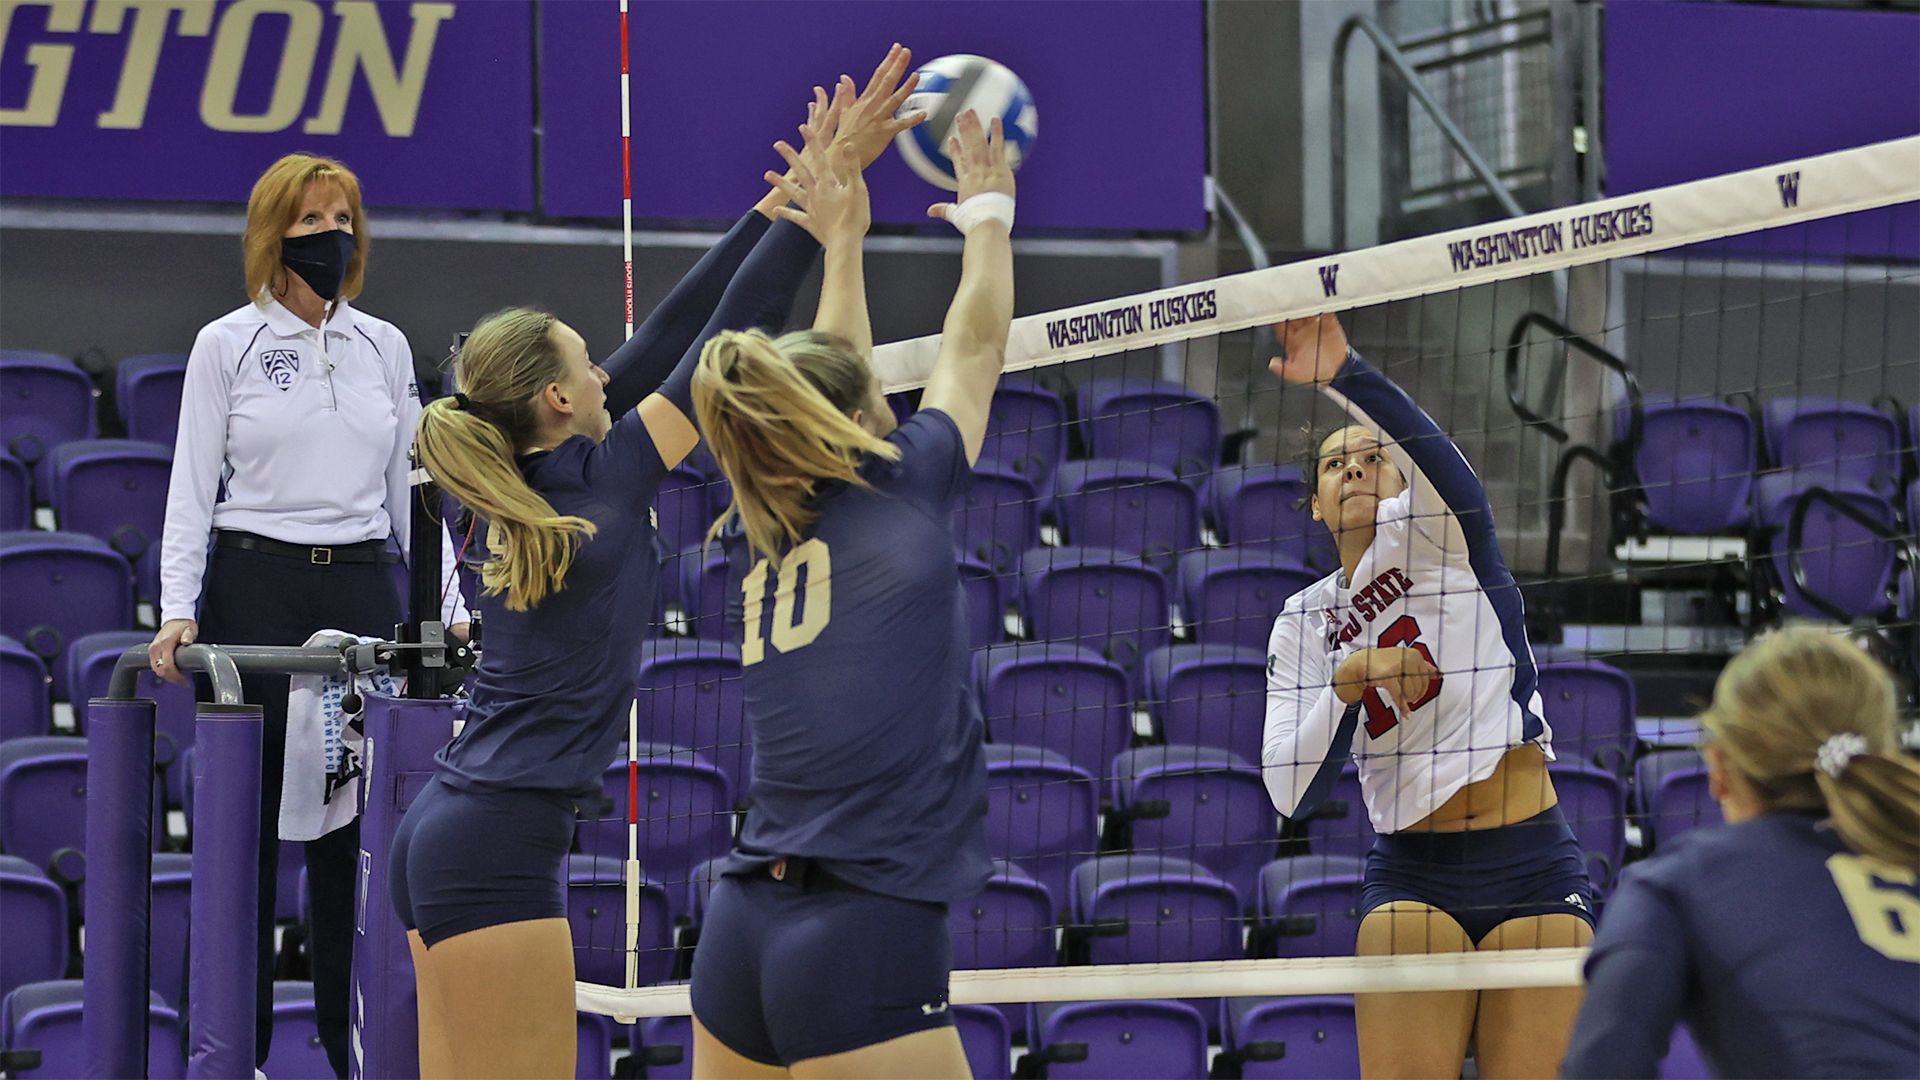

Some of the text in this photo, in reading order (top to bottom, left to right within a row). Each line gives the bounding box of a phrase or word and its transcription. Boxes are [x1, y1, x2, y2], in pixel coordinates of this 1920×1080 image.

[1776, 171, 1800, 209] W
[1448, 203, 1653, 273] WASHINGTON HUSKIES
[1319, 264, 1339, 298] W
[1046, 290, 1217, 349] WASHINGTON HUSKIES
[261, 350, 299, 377] PAC
[275, 373, 291, 385] 12
[741, 537, 831, 666] 10
[1352, 567, 1414, 622] STATE
